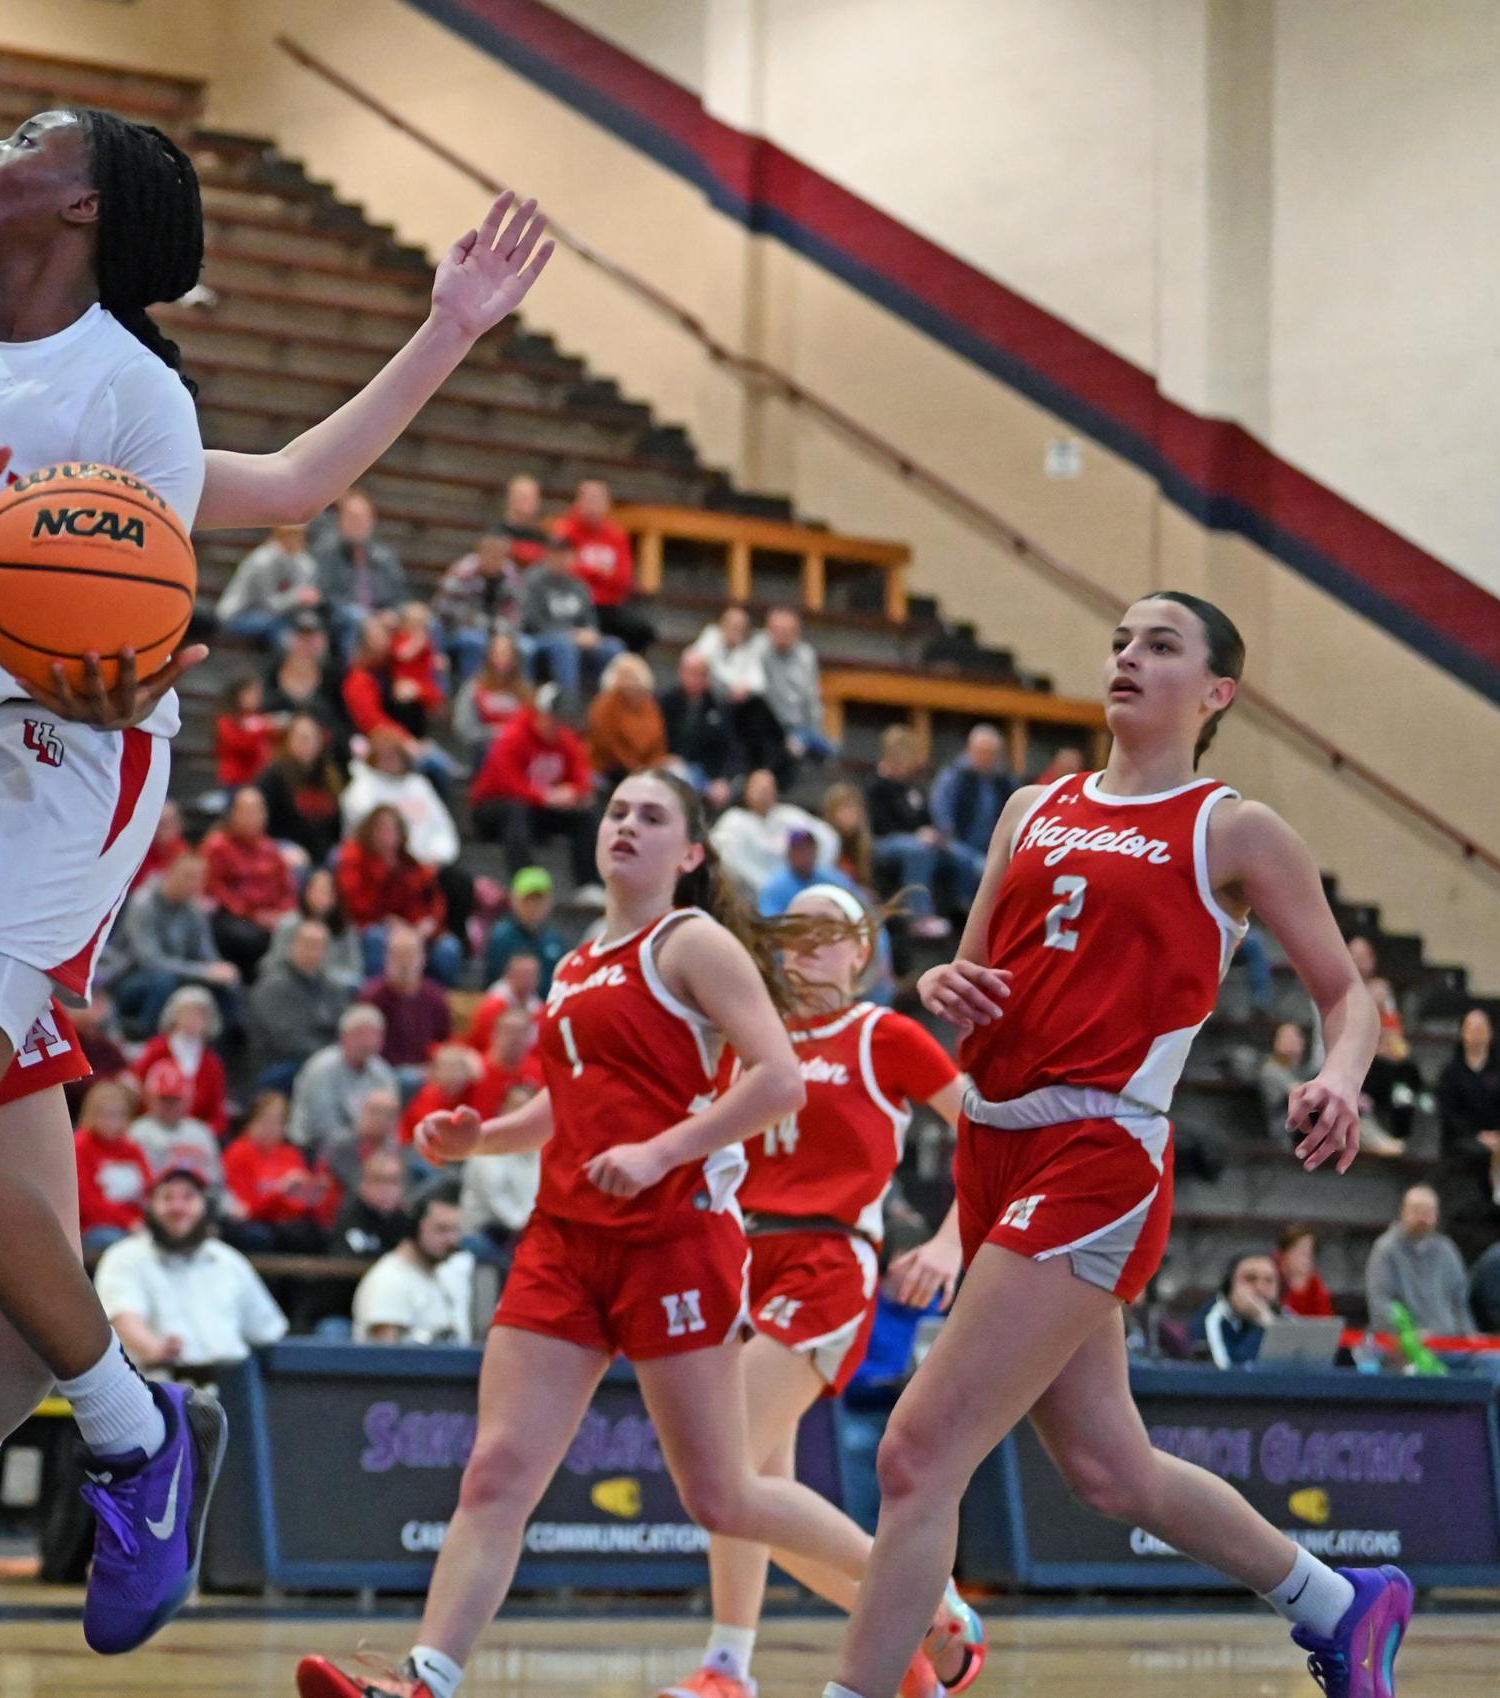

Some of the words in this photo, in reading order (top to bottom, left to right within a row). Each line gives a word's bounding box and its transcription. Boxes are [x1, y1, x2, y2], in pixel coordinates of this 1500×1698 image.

[32, 508, 145, 548] NCAA
[1016, 816, 1172, 867] Hazleton
[1043, 875, 1088, 952] 2
[558, 1016, 584, 1079] 1
